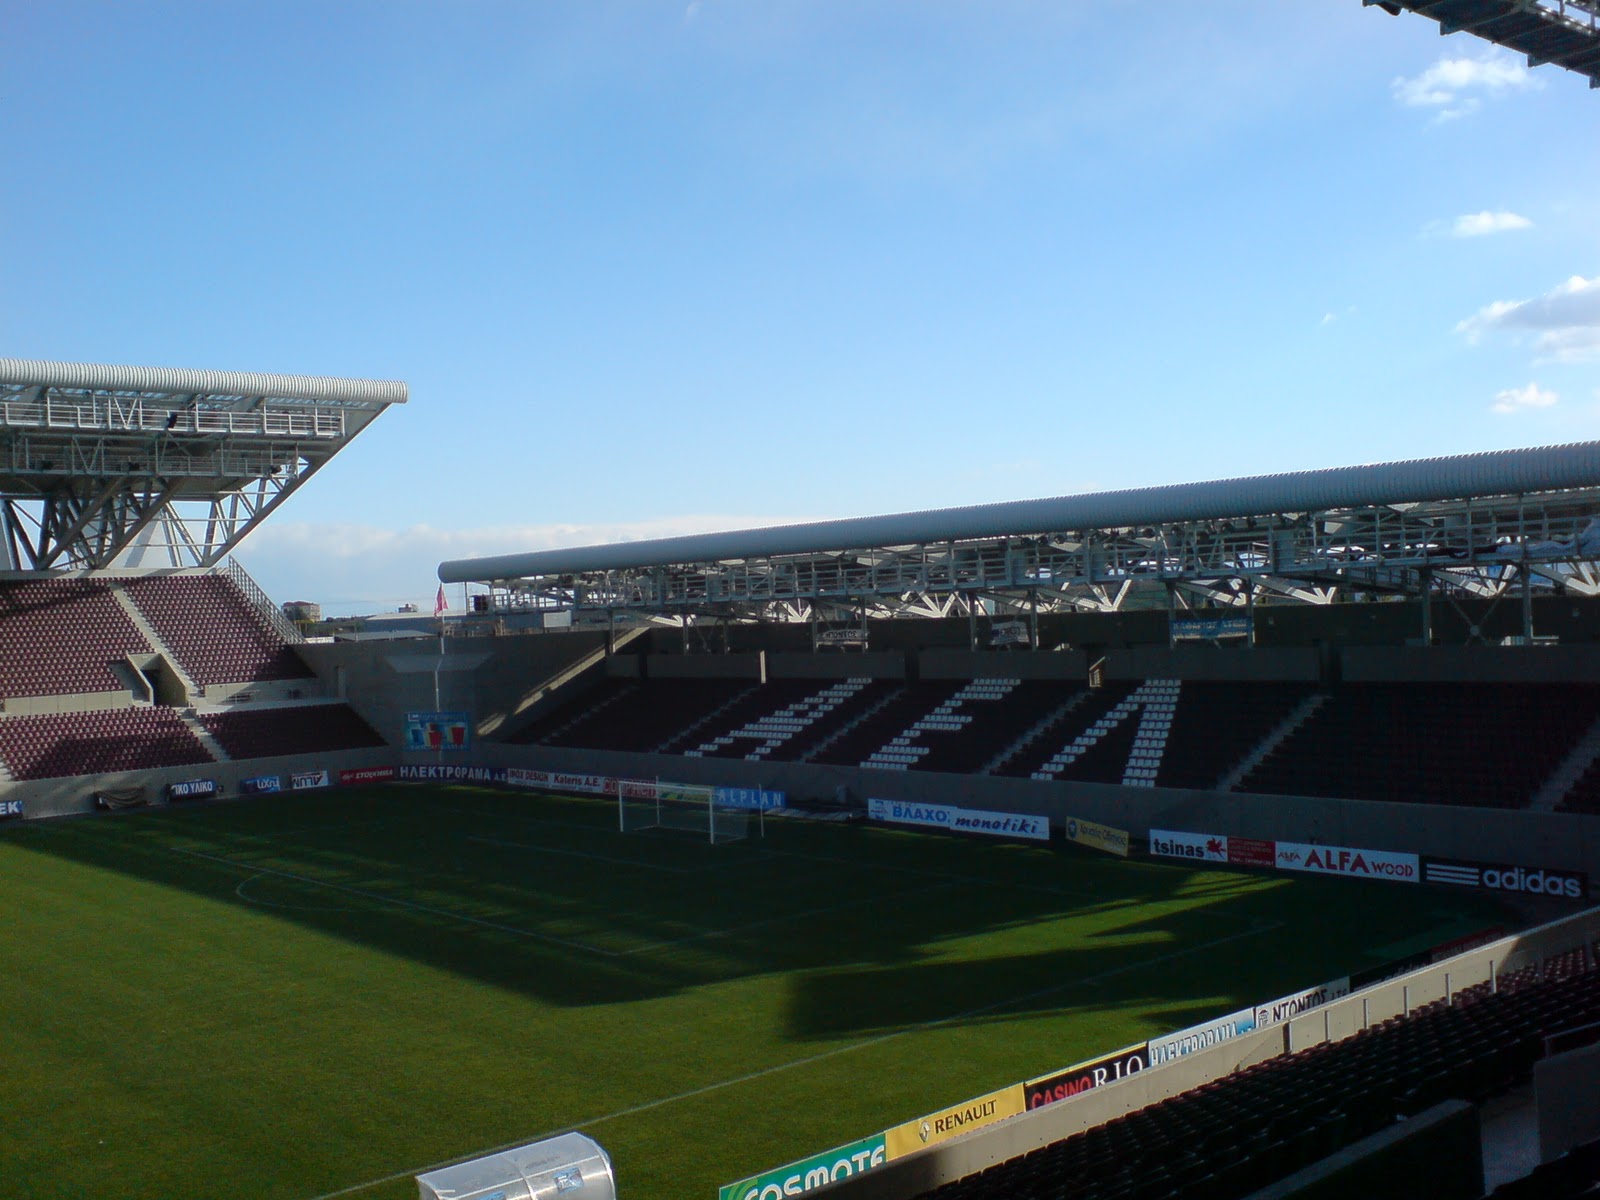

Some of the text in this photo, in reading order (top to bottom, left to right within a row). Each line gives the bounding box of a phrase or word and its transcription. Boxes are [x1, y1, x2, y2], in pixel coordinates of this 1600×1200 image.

[400, 765, 491, 781] ΗΛΕΚΤΡΟΡΑΜΑ
[1153, 838, 1205, 858] tsinas
[1304, 848, 1413, 877] ALFA WOOD
[1482, 867, 1582, 898] adidas
[1031, 1055, 1144, 1109] CASINO RIO
[934, 1099, 997, 1134] RENAULT
